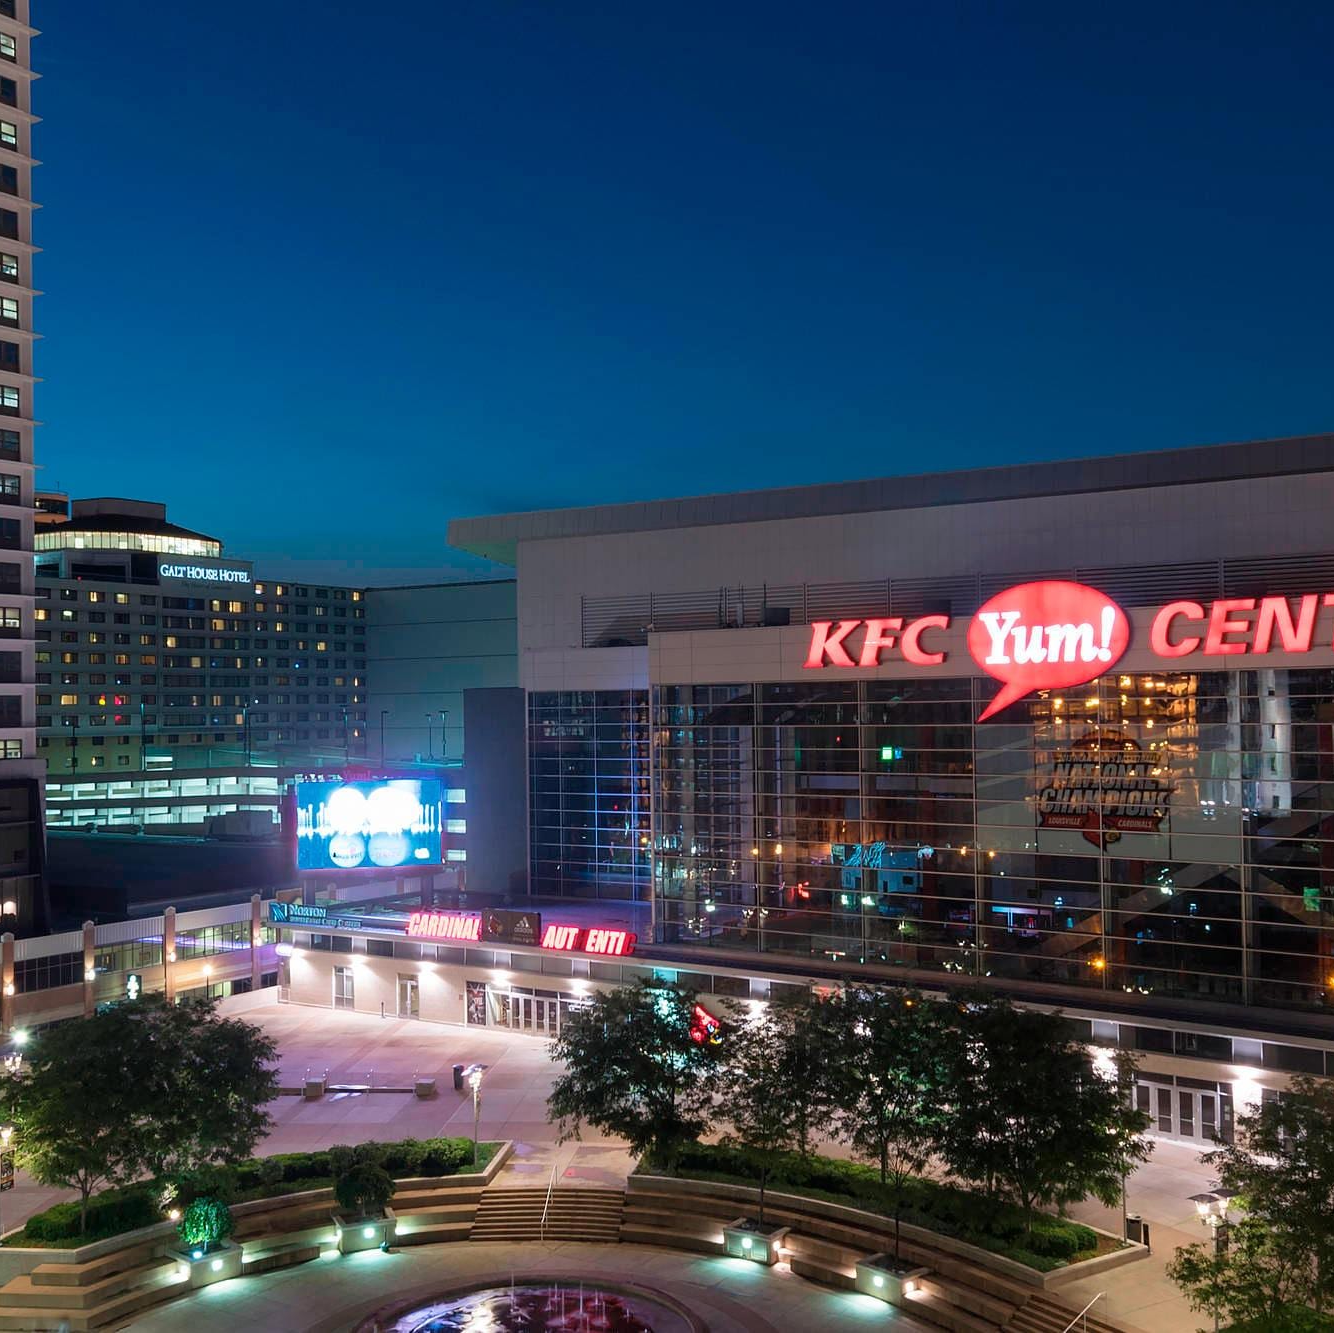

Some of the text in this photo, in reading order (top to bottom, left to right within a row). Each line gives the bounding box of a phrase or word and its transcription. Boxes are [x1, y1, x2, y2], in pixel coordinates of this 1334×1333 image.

[160, 564, 251, 583] GALT HOUSE HOTEL
[802, 614, 949, 669] KFC
[978, 605, 1116, 665] Yum!
[1053, 763, 1159, 789] NATIONAL
[1040, 788, 1169, 817] CHAMPIONS
[1047, 817, 1153, 829] LOUISVILLE CARDINALS
[289, 903, 327, 918] NORTON
[408, 912, 482, 941] CARDINAL
